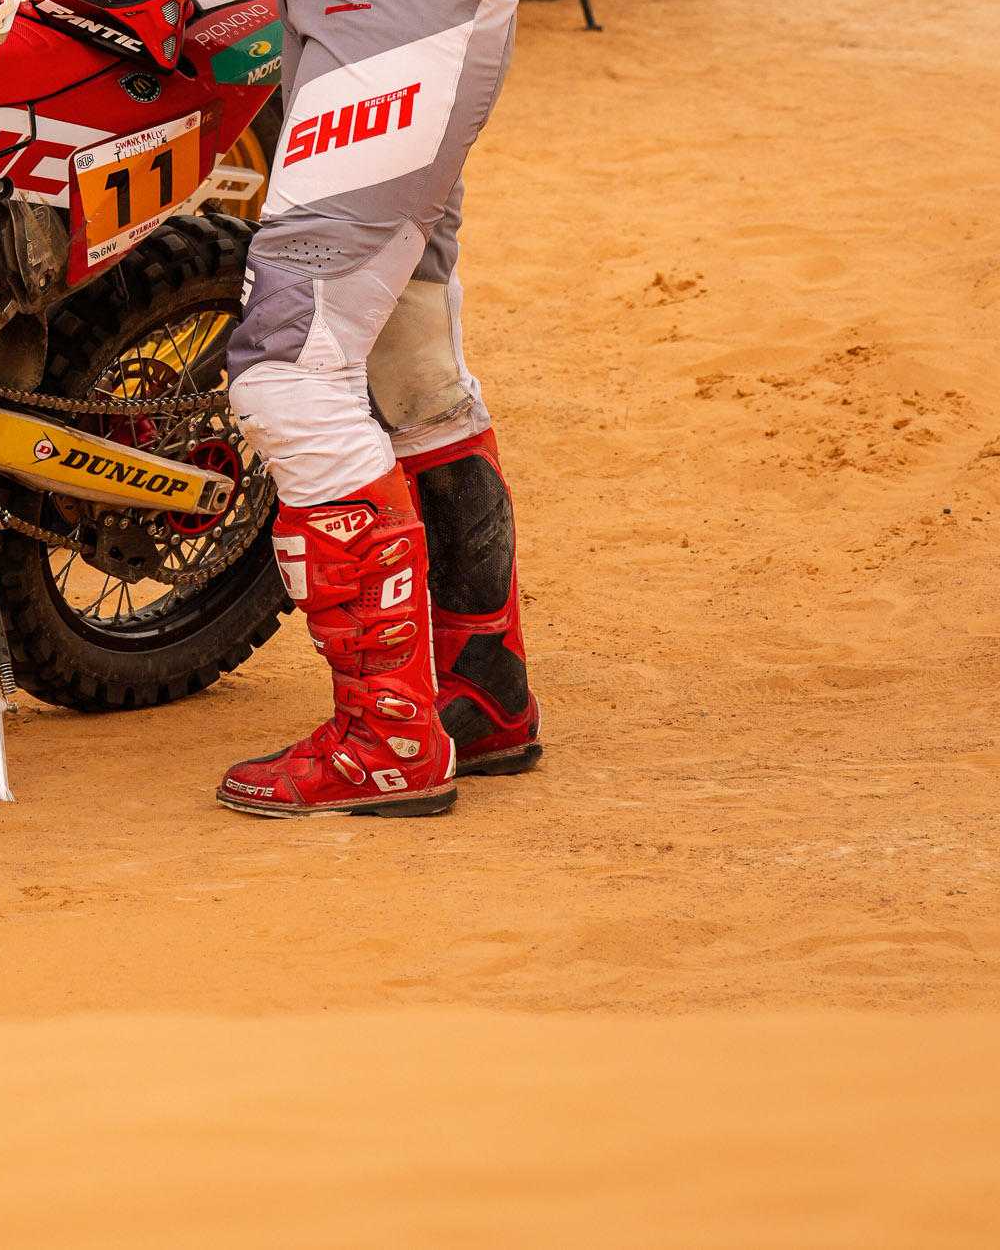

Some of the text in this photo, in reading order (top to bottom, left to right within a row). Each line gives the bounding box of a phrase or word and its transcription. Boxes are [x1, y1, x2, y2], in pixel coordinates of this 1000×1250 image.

[35, 0, 145, 53] FANTIC
[194, 3, 269, 47] PIONONO
[364, 88, 408, 109] RACE GEAR
[283, 82, 422, 169] SHOT
[114, 136, 169, 163] TUNISIA
[115, 129, 165, 152] SWANK RALLY
[104, 148, 173, 229] 11
[135, 217, 160, 236] YAMAHA
[100, 241, 118, 257] GNV
[59, 448, 190, 498] DUNLOP
[341, 511, 369, 533] 12
